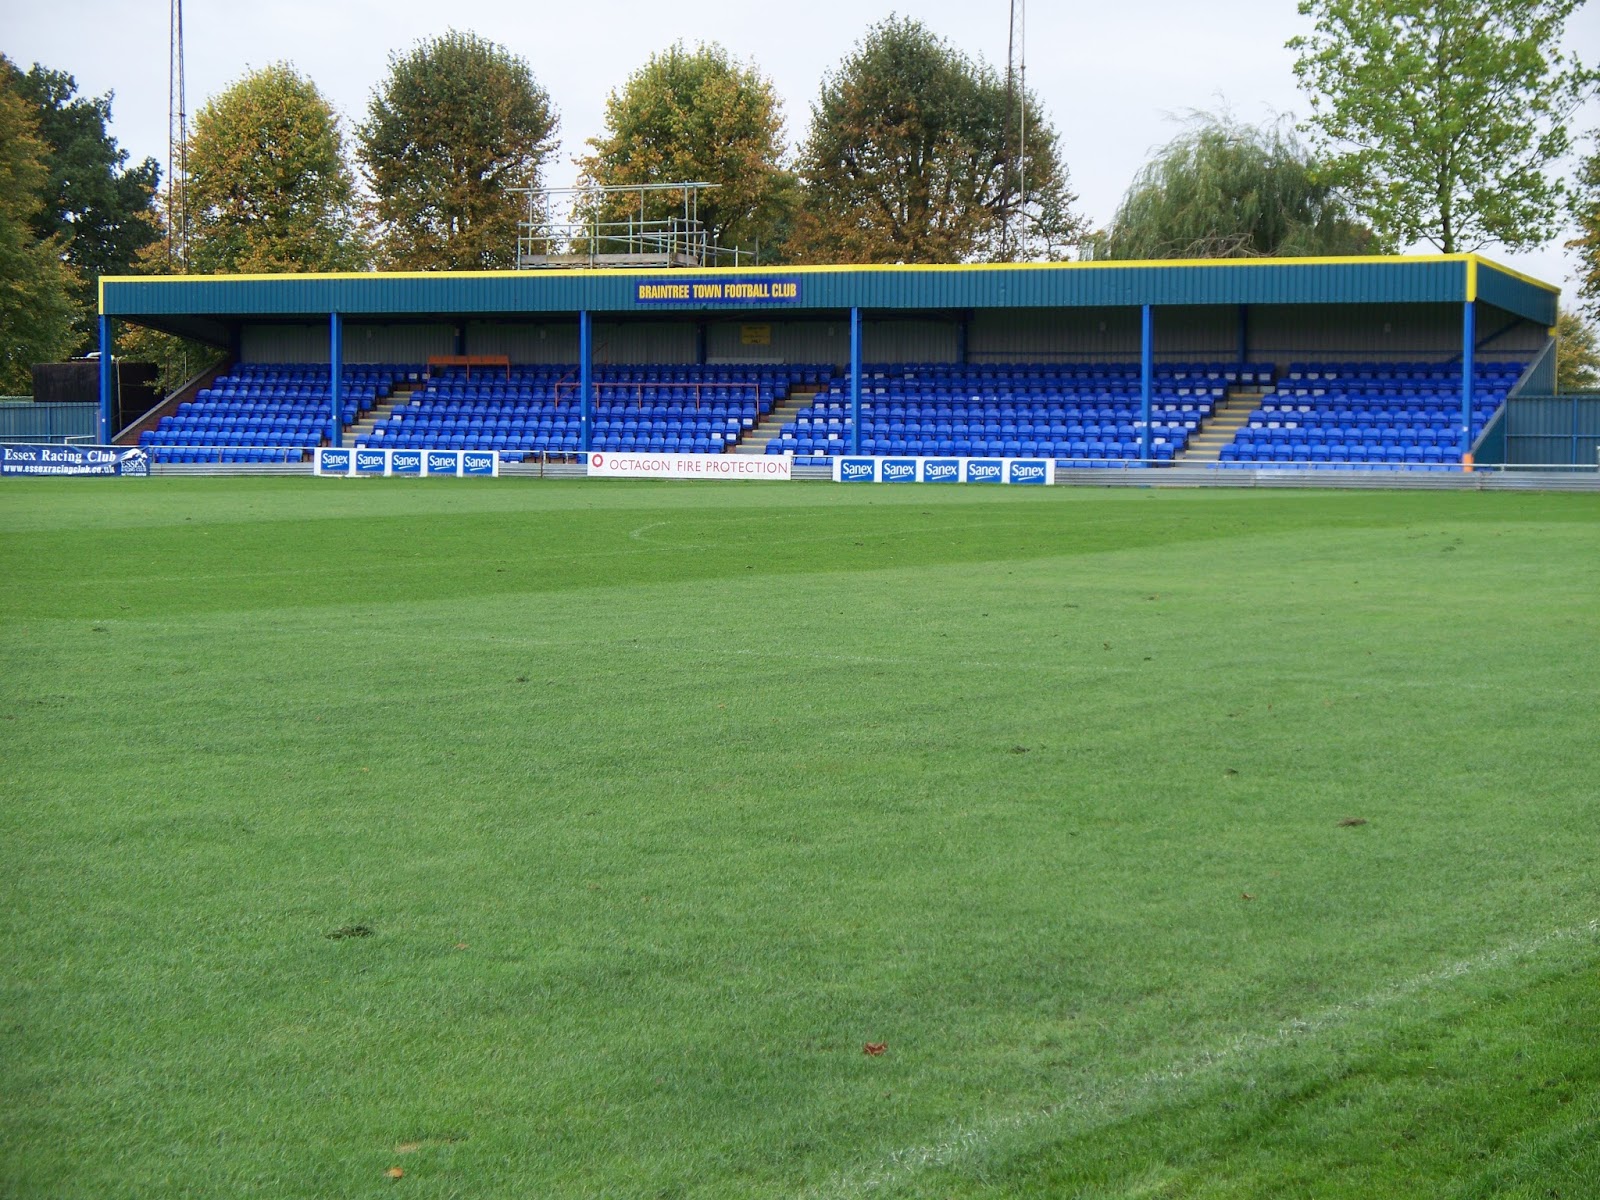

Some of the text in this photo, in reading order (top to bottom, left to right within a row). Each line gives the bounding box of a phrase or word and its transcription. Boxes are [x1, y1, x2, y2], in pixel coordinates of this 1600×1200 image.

[639, 283, 797, 299] BRAINTREE TOWN FOOTBALL CLUB
[4, 448, 116, 464] Essex Racing Club
[322, 452, 348, 465] Sanex
[357, 453, 384, 466] Sanex
[393, 454, 420, 466] Sanex
[429, 455, 456, 467] Sanex
[464, 455, 491, 468] Sanex
[3, 464, 116, 475] www.essexracingclub.co.uk
[609, 459, 788, 474] OCTAGON FIRE PROTECTION
[842, 462, 873, 475] Sanex
[883, 463, 914, 475] Sanex
[925, 463, 957, 476] Sanex
[969, 463, 1001, 476] Sanex
[1011, 464, 1045, 477] Sanex
